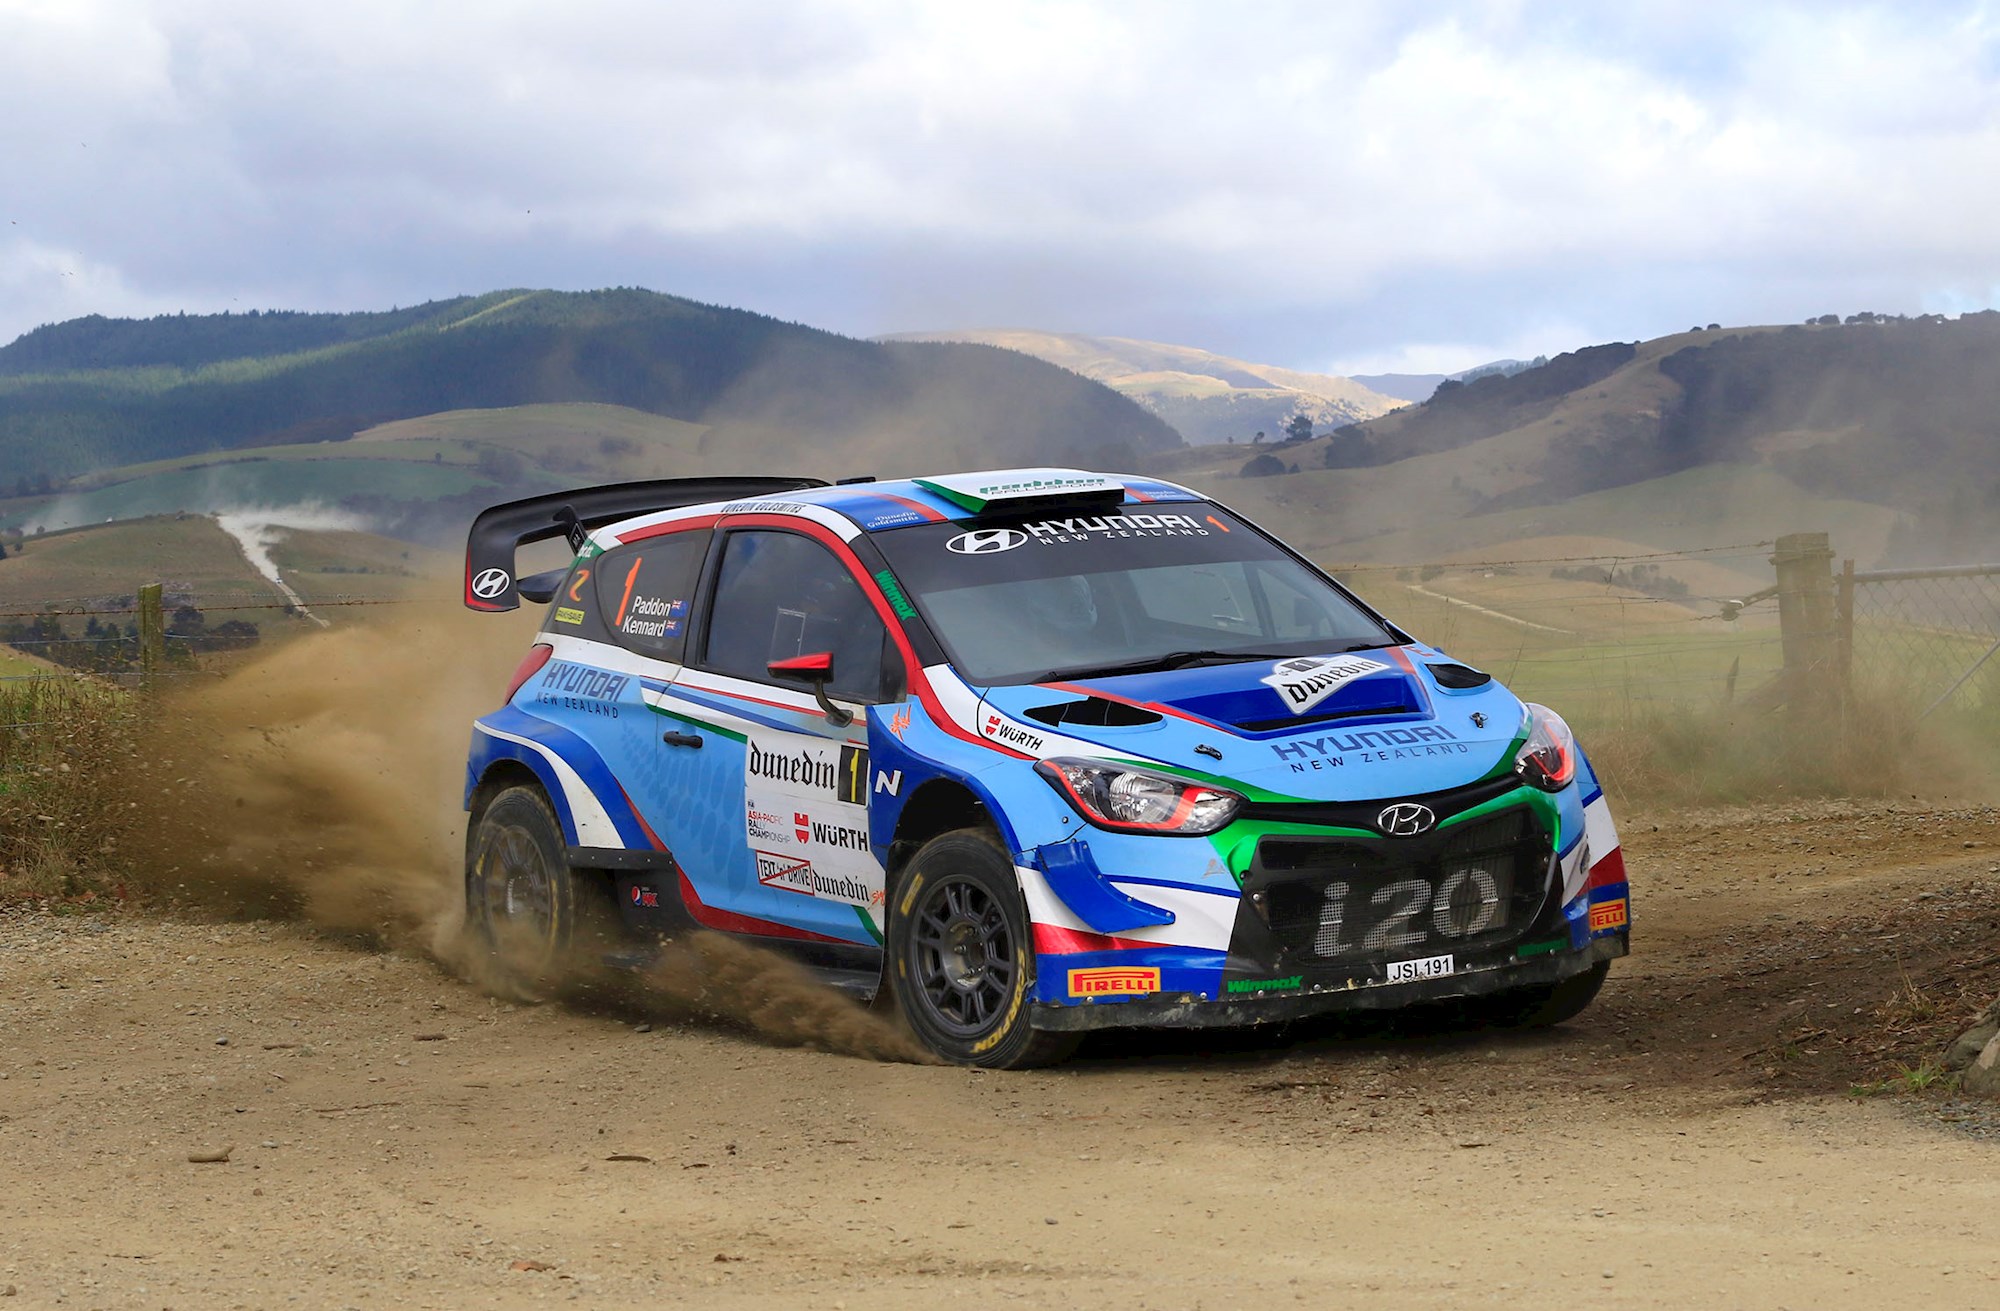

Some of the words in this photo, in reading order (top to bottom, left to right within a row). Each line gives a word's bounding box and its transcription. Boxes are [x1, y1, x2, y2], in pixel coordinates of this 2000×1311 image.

[1023, 514, 1202, 538] HYUNDAI
[1039, 532, 1089, 546] NEW
[1106, 528, 1210, 540] ZEALAND
[1206, 515, 1230, 533] 1
[615, 556, 643, 626] 1
[632, 595, 672, 617] Paddon
[622, 615, 666, 637] Kennard
[542, 662, 630, 702] HYUNDAI
[537, 692, 558, 706] NEW
[564, 697, 619, 719] ZEALAND
[1271, 725, 1458, 761] HYUNDAI
[749, 740, 836, 790] dunedin
[1290, 756, 1345, 774] NEW
[1364, 742, 1469, 763] ZEALAND
[850, 748, 860, 803] 1
[748, 819, 767, 830] RALLY
[748, 828, 791, 843] CHAMPIONSHIP
[759, 859, 776, 877] TEXT
[787, 865, 811, 887] DRIVE
[812, 869, 870, 902] dunedin
[1313, 868, 1500, 958] i20
[1424, 957, 1450, 976] 191
[1073, 970, 1156, 993] PIRELLI
